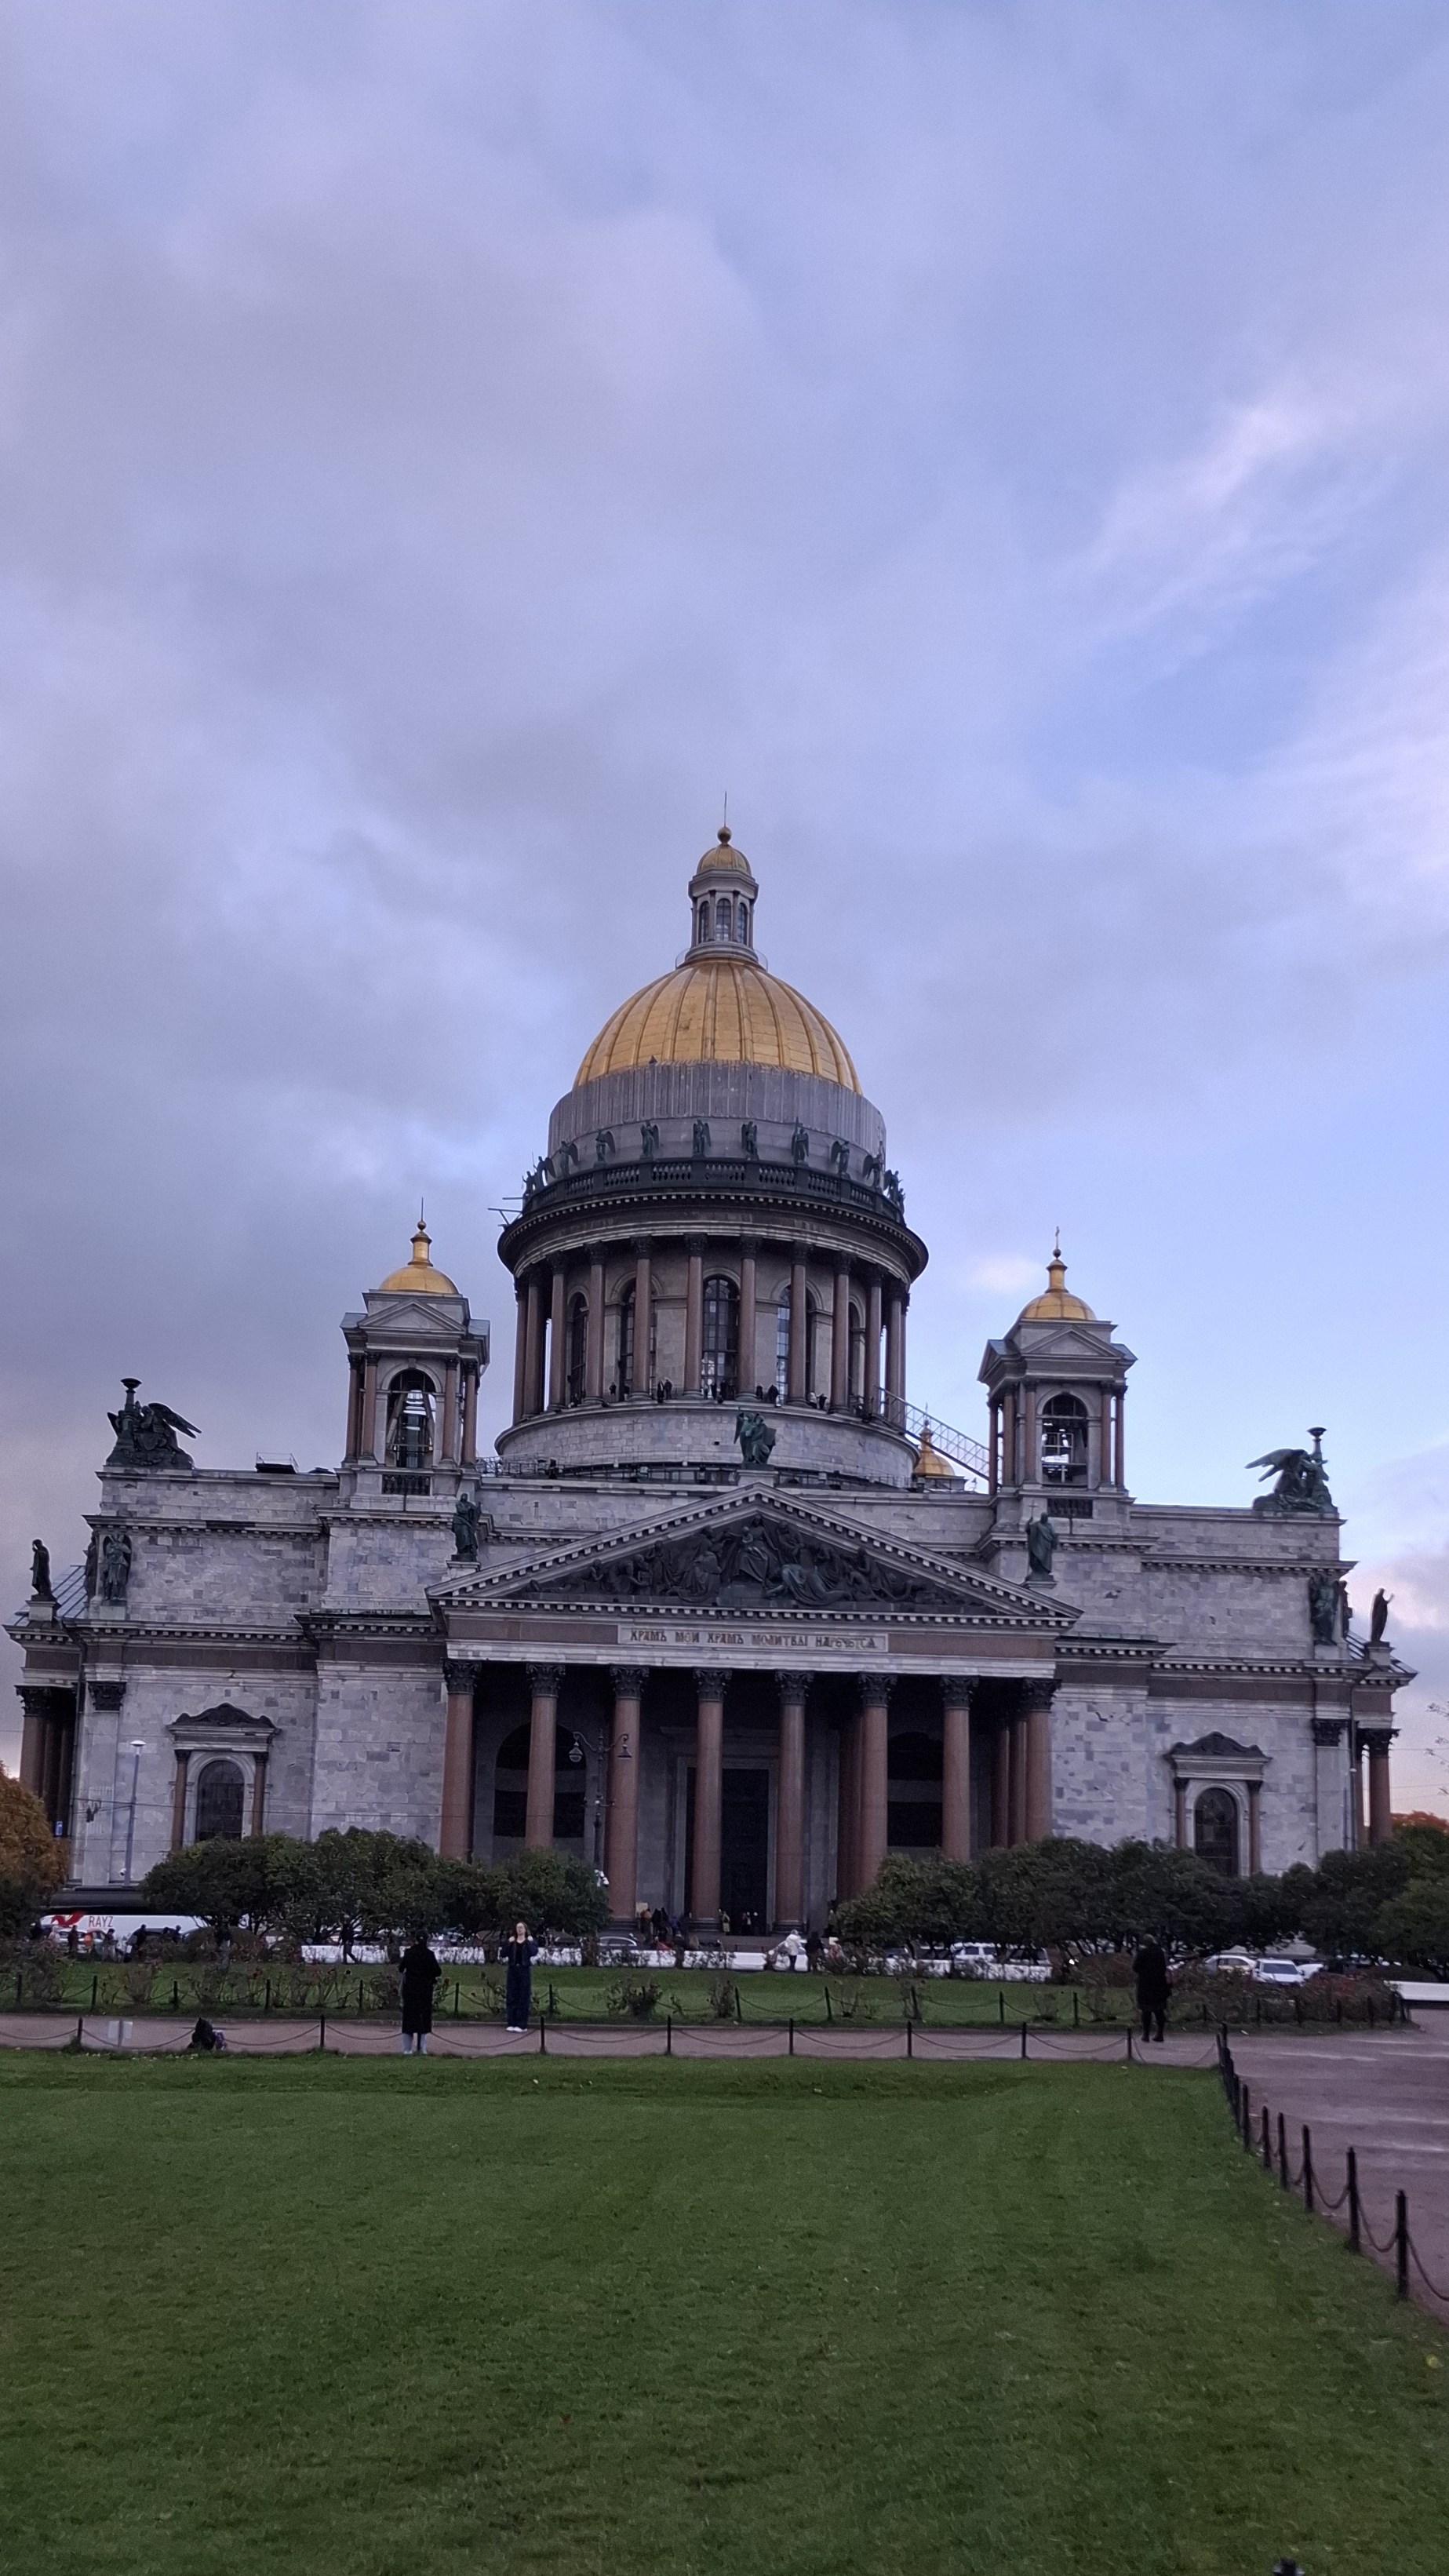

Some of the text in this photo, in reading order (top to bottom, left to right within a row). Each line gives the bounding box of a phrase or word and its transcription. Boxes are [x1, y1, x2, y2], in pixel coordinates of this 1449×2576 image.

[630, 1630, 667, 1642] ХРАМЪ
[707, 1632, 744, 1645] ХРАМЪ
[88, 1915, 114, 1928] RAYZ
